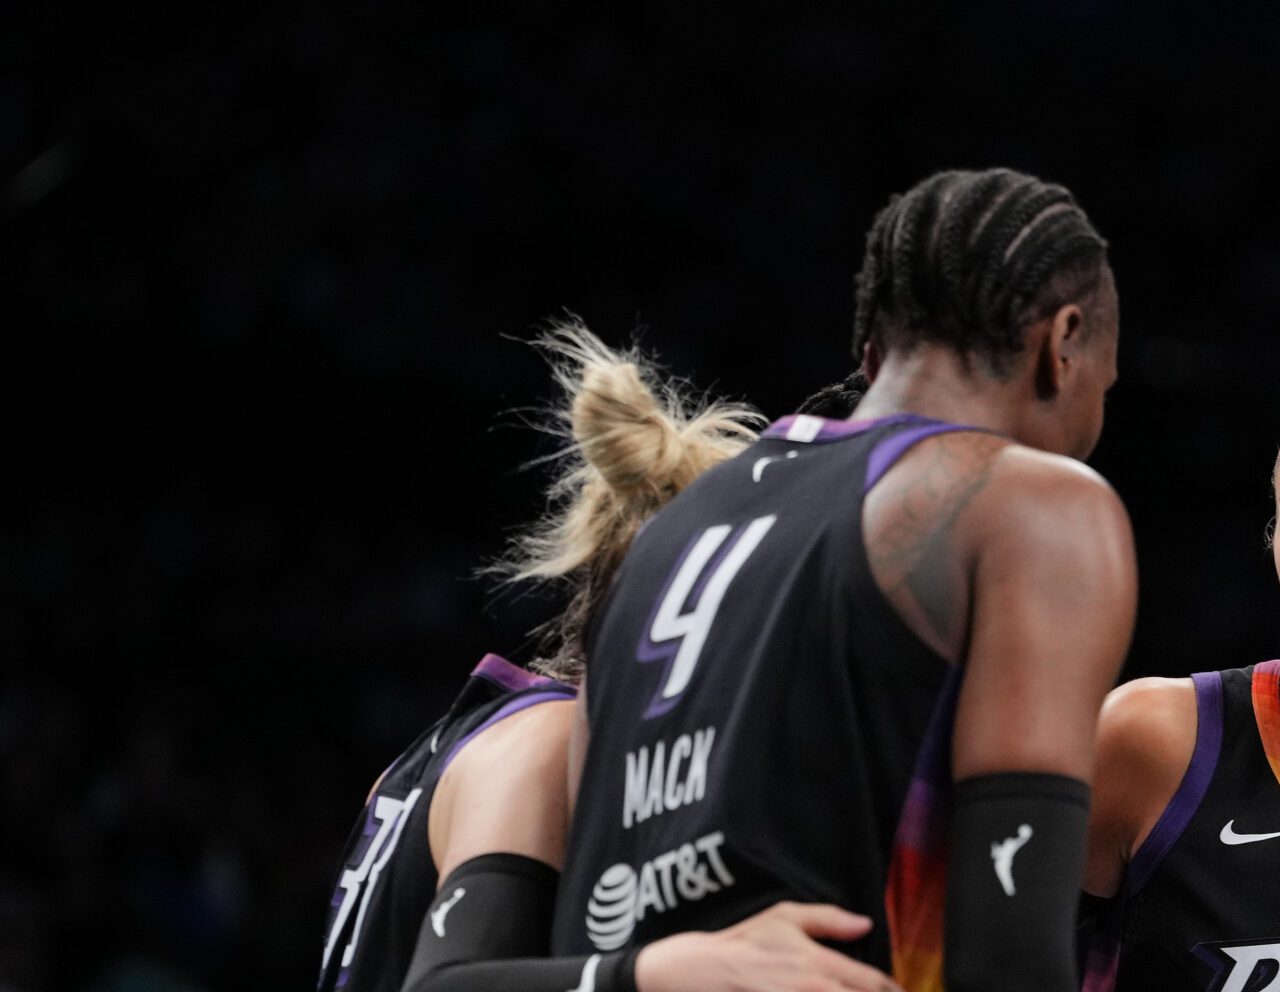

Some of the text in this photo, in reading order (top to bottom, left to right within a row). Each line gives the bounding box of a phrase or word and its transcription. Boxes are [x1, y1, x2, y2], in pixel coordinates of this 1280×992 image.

[650, 514, 777, 699] 4
[622, 725, 716, 829] MACK
[635, 830, 736, 922] AT&T
